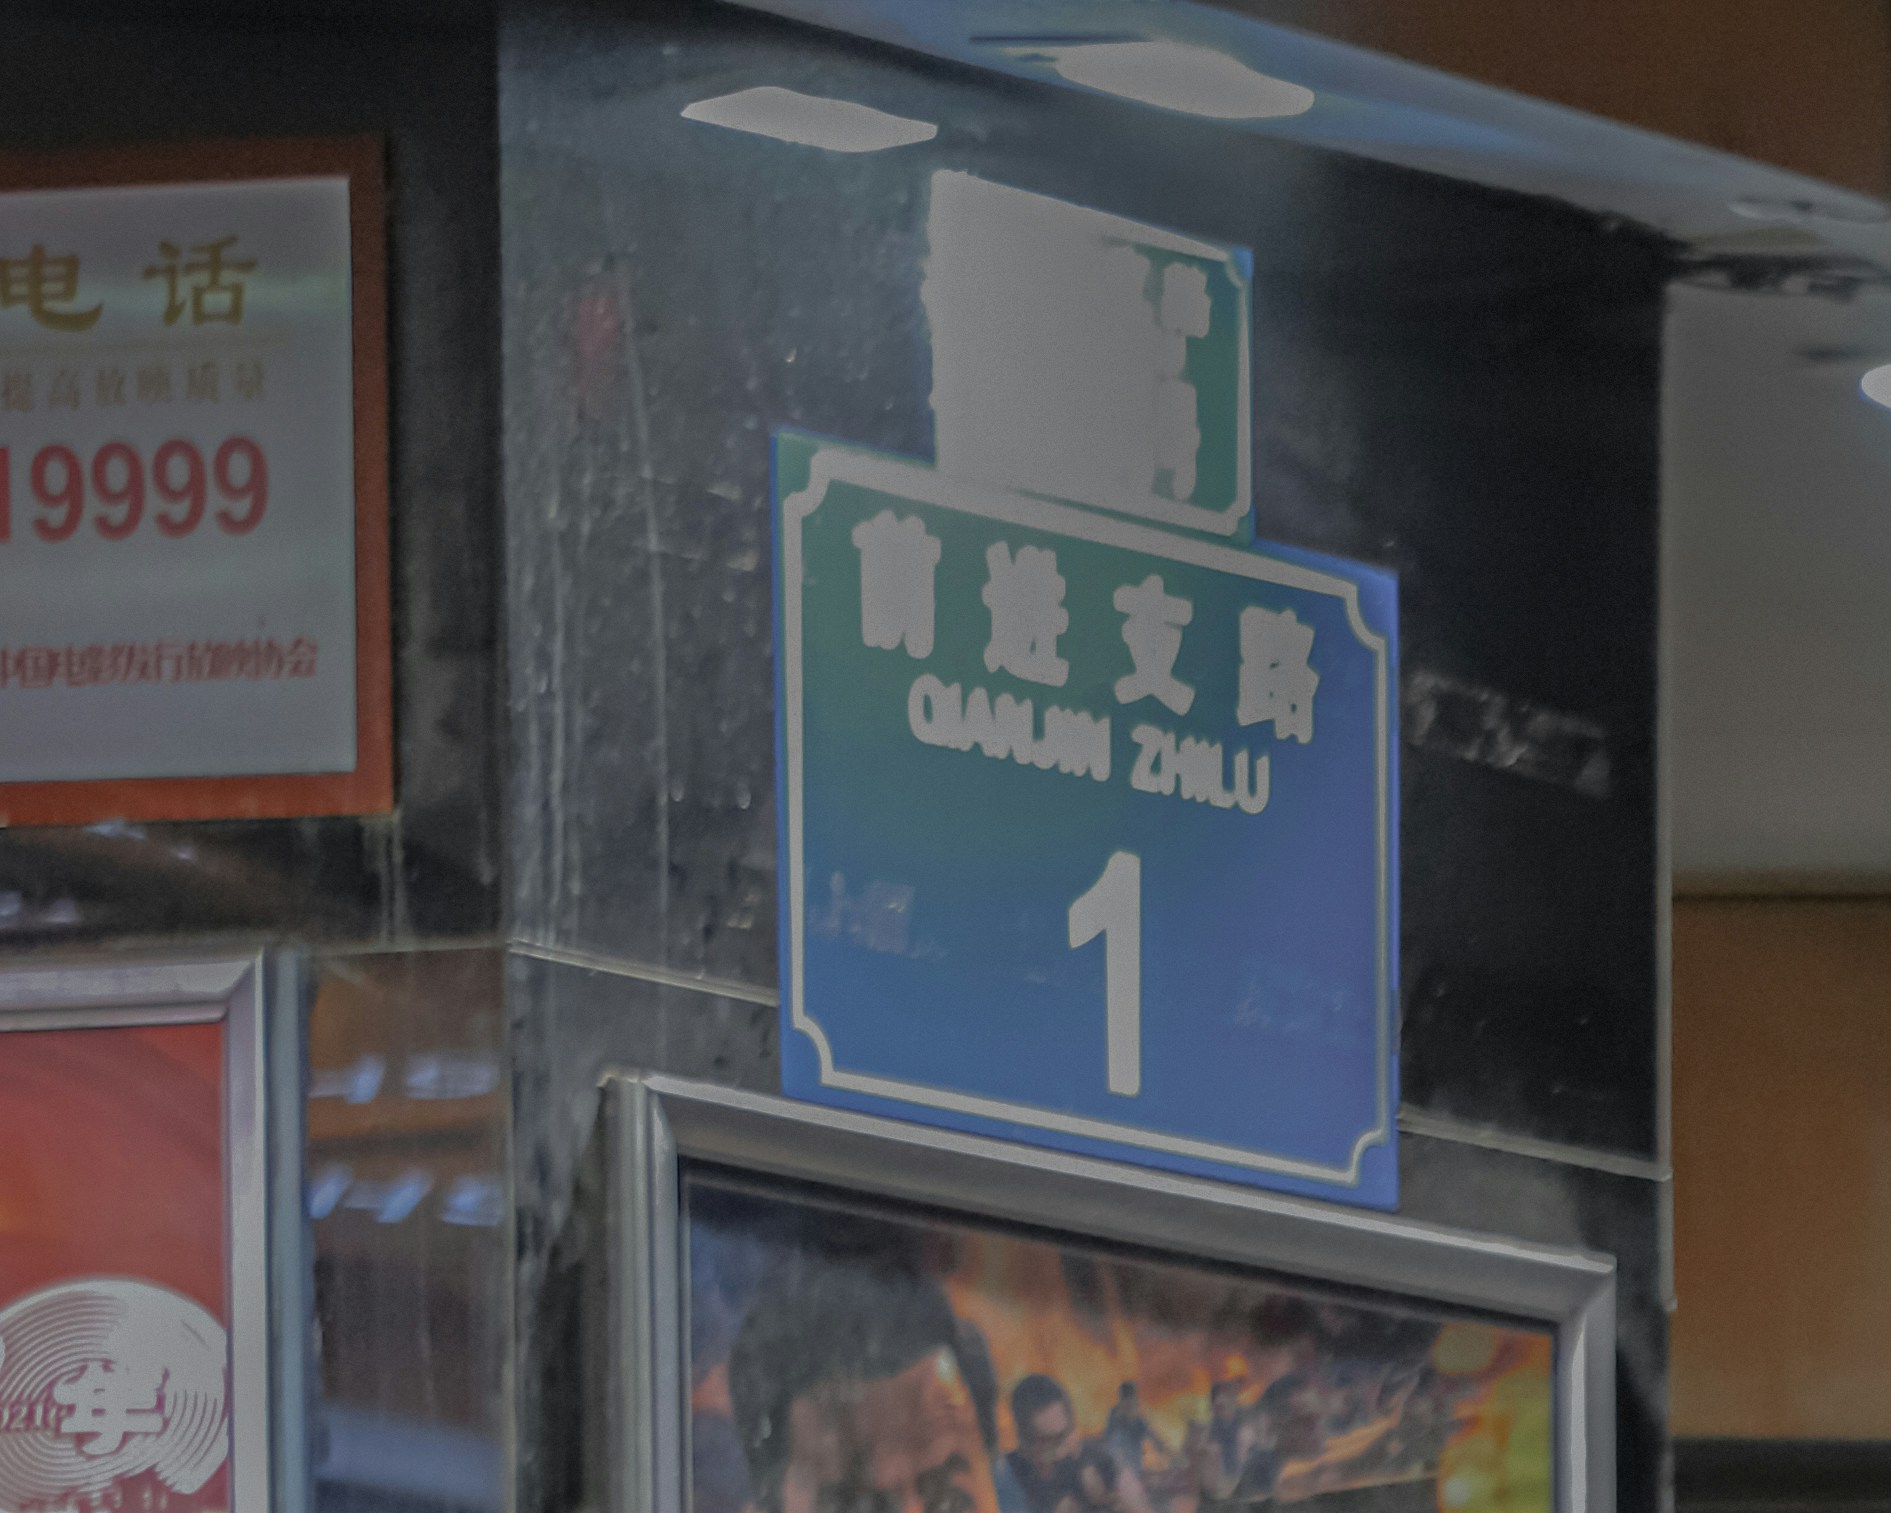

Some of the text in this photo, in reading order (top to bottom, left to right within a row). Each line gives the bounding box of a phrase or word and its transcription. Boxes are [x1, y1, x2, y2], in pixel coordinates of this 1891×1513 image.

[907, 672, 1271, 815] QIANJIN ZHILU
[1068, 850, 1142, 1097] 1
